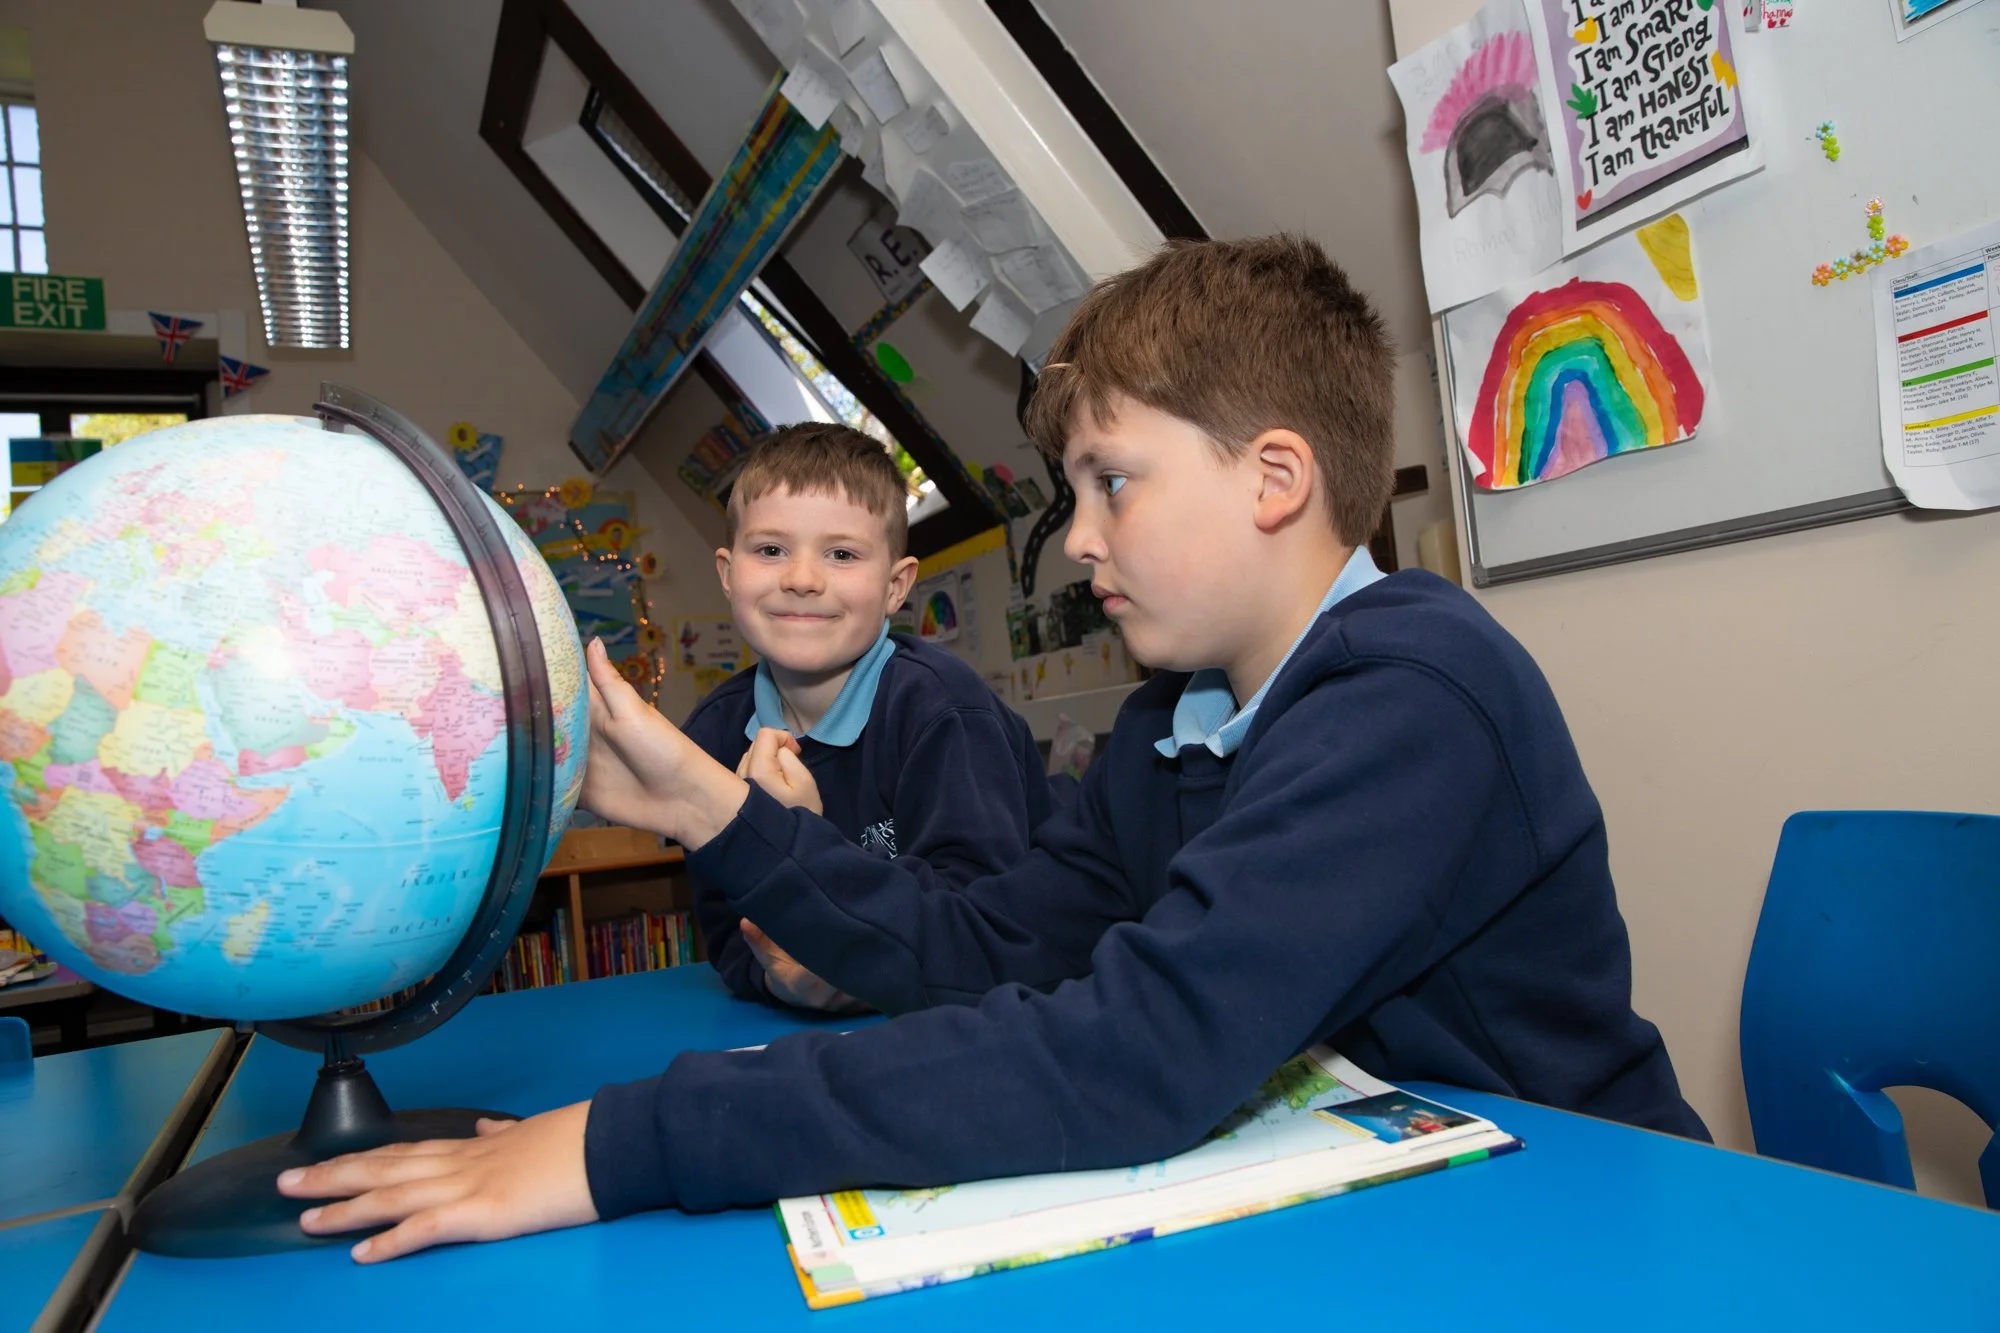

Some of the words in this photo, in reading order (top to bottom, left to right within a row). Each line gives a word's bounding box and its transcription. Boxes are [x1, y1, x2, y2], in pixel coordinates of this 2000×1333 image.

[1593, 12, 1611, 44] I
[1610, 0, 1635, 28] am
[1575, 47, 1594, 85] I
[1594, 44, 1622, 72] am
[1594, 79, 1612, 113] I
[1612, 70, 1641, 102] am
[1586, 112, 1600, 149] I
[1604, 110, 1634, 142] am
[1586, 151, 1599, 186] I
[1602, 147, 1634, 176] am
[12, 276, 87, 303] FIRE
[14, 302, 88, 328] EXIT
